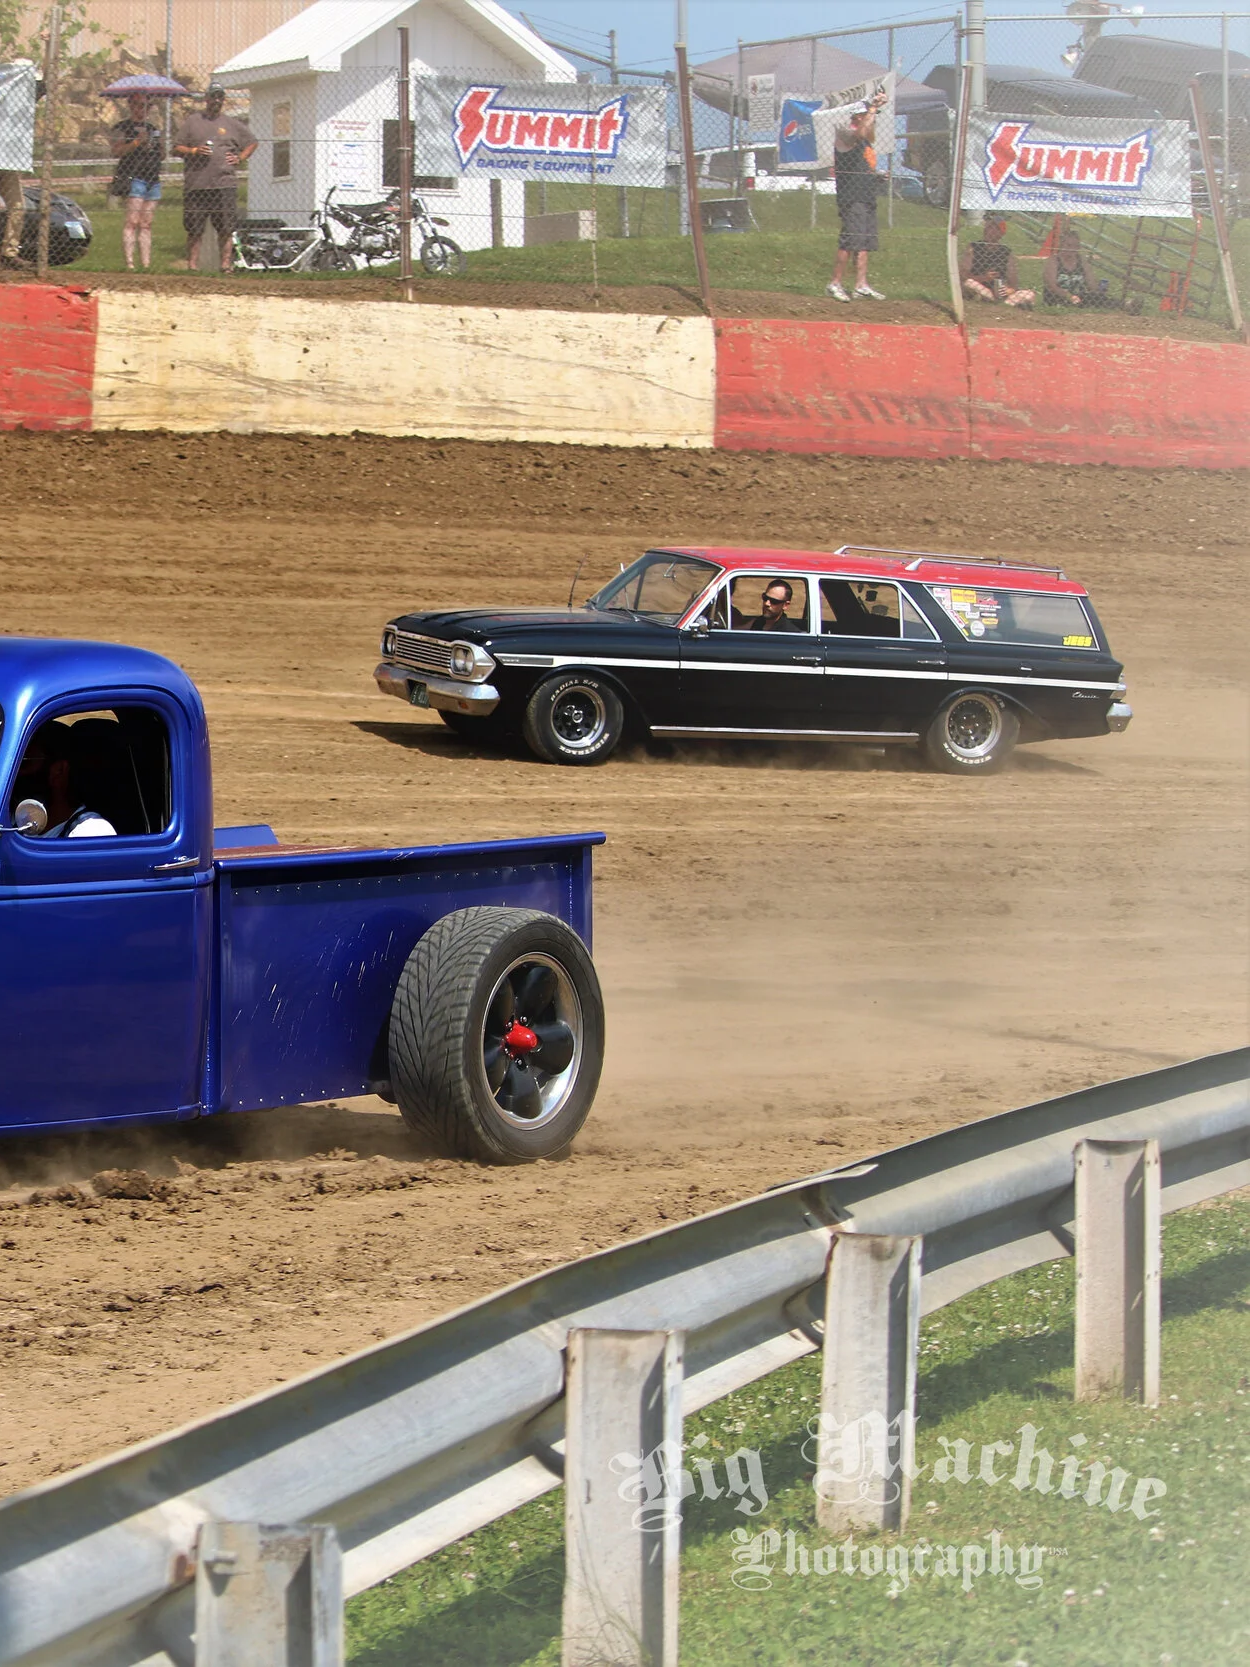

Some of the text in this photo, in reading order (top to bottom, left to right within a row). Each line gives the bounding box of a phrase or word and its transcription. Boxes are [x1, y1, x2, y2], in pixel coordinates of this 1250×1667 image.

[476, 158, 615, 174] RACING EQUIPMENT
[1007, 191, 1057, 202] RACING
[551, 679, 579, 701] RADIAL
[558, 733, 610, 755] WIDETRACK
